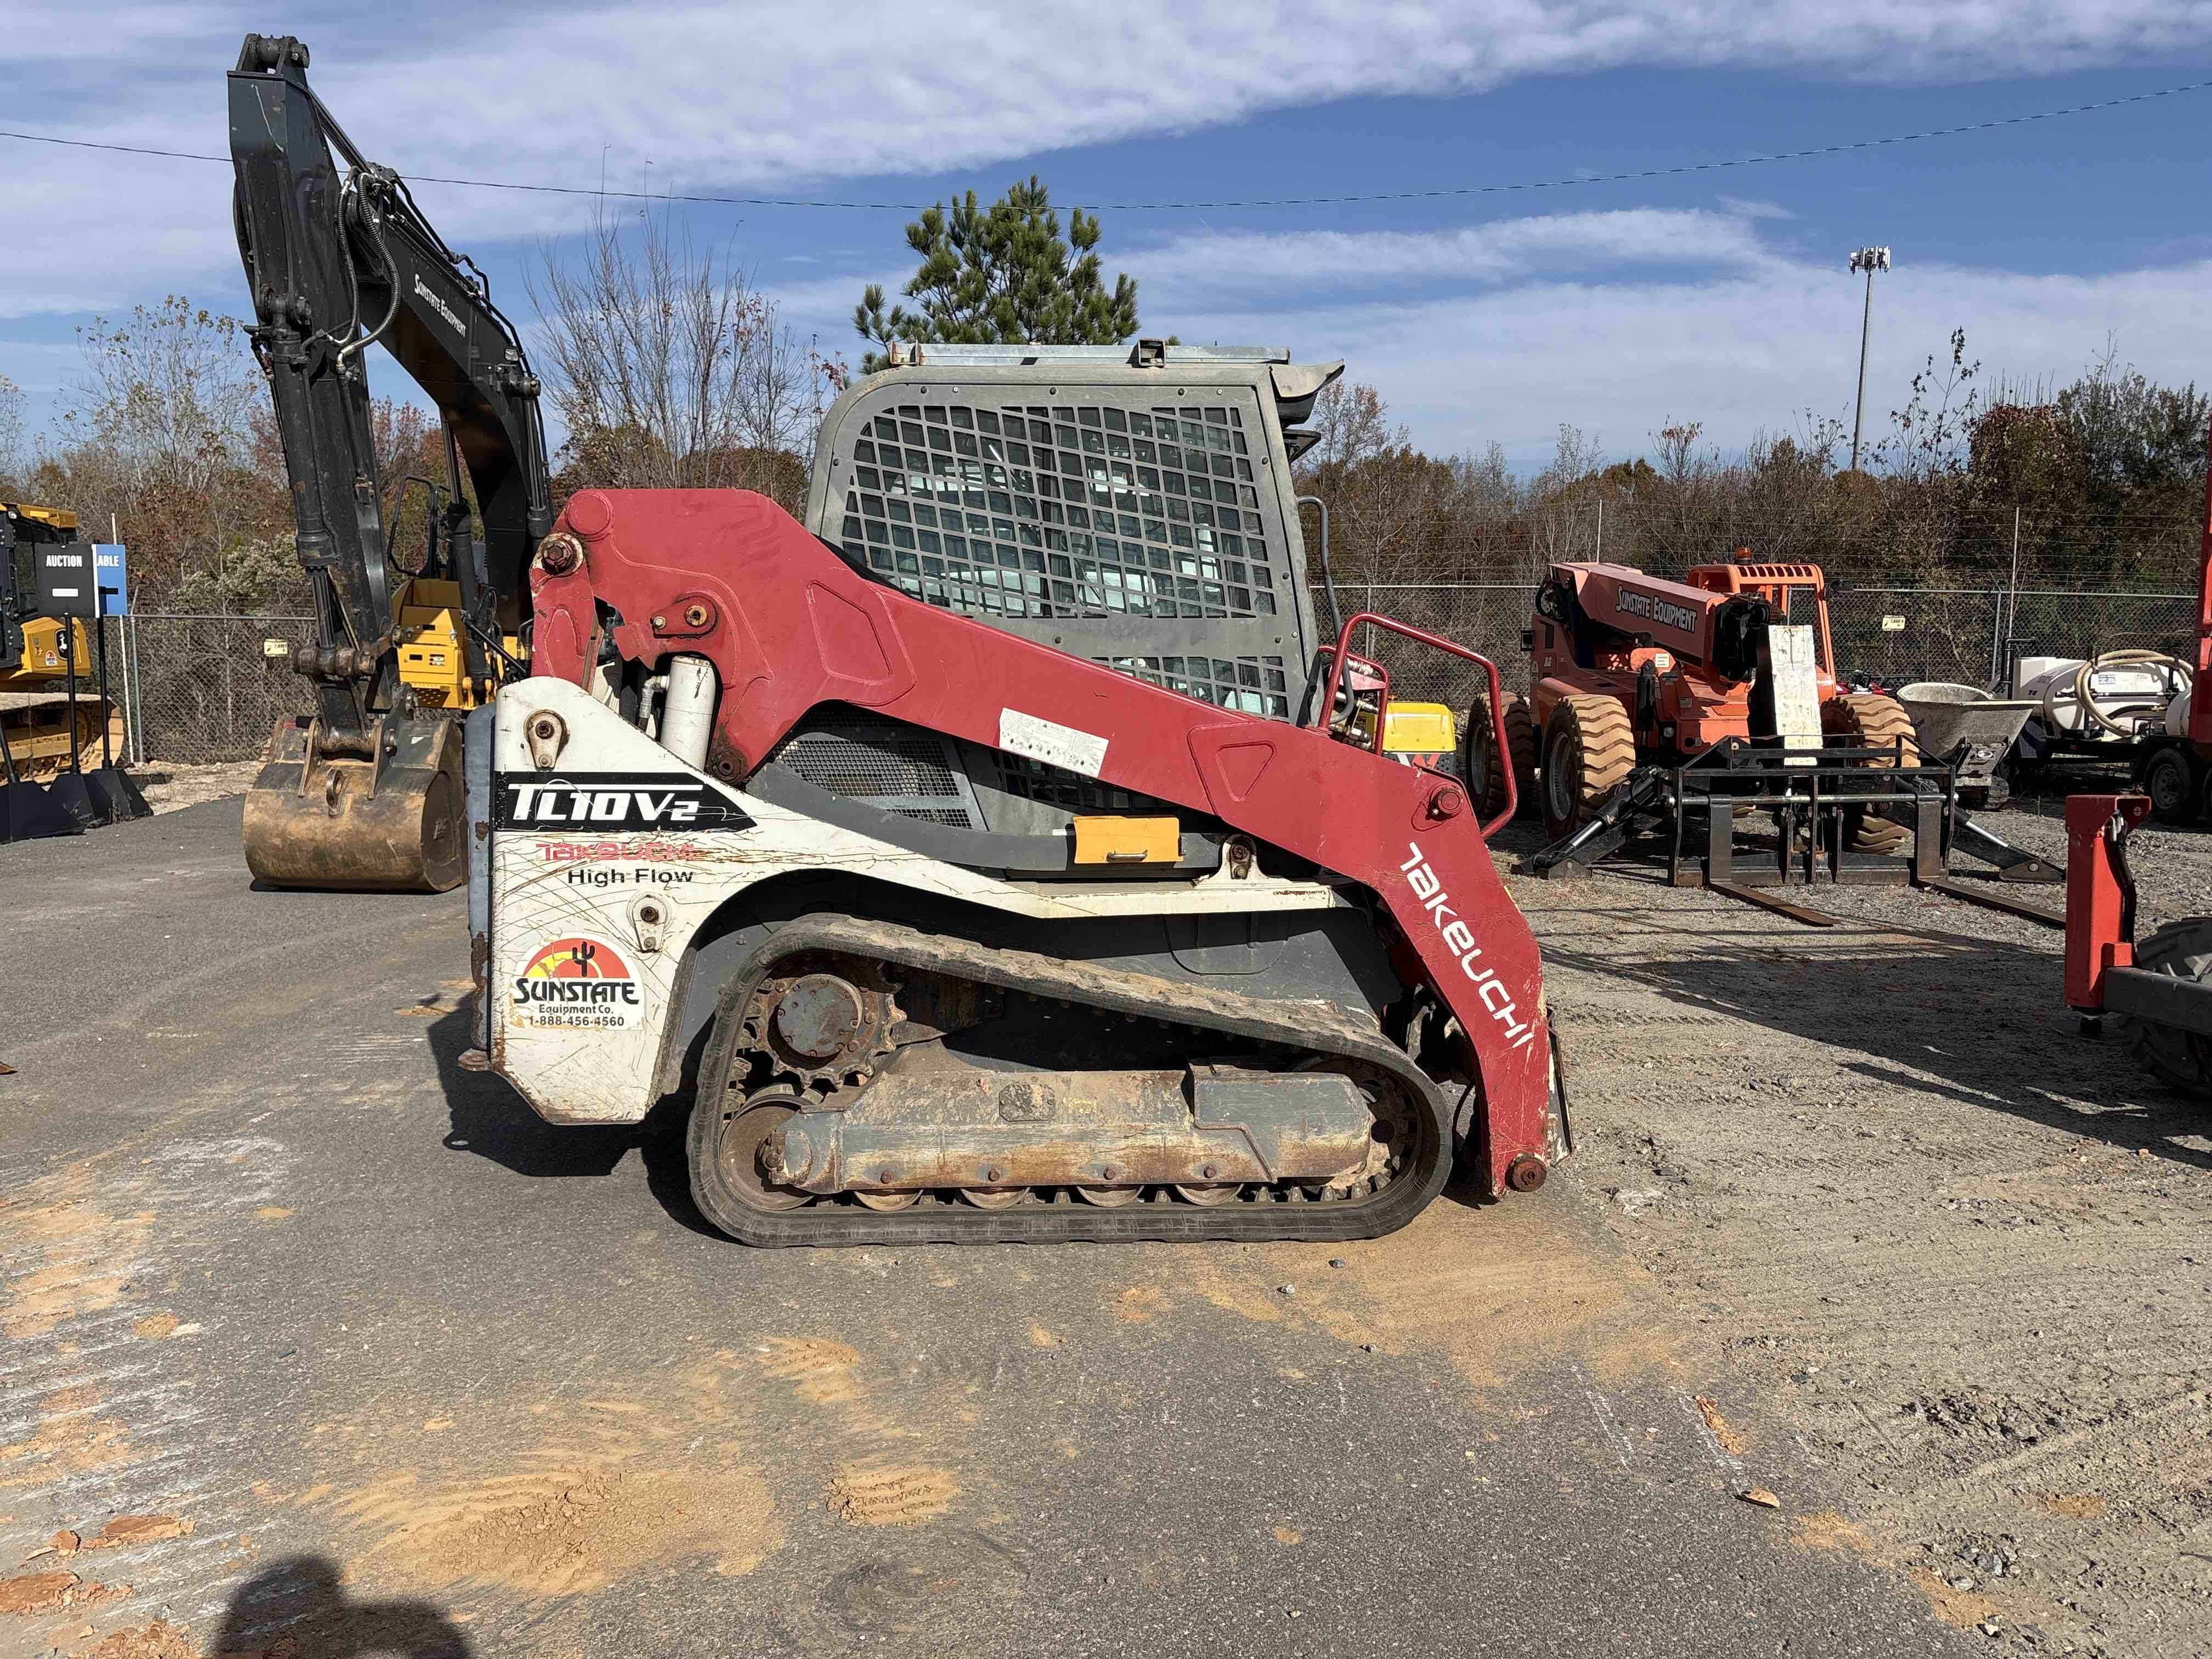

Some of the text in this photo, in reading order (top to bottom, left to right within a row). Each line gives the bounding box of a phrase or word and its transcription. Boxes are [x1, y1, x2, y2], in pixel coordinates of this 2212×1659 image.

[46, 555, 119, 567] AUCTION ABLE
[1616, 585, 1697, 633] SUNSTATE EQUIPMENT
[568, 868, 695, 888] High Flow
[514, 978, 640, 1005] SUNSTATE
[538, 1004, 614, 1015] Equipment Co.
[528, 1015, 625, 1026] 1-888-456-4560
